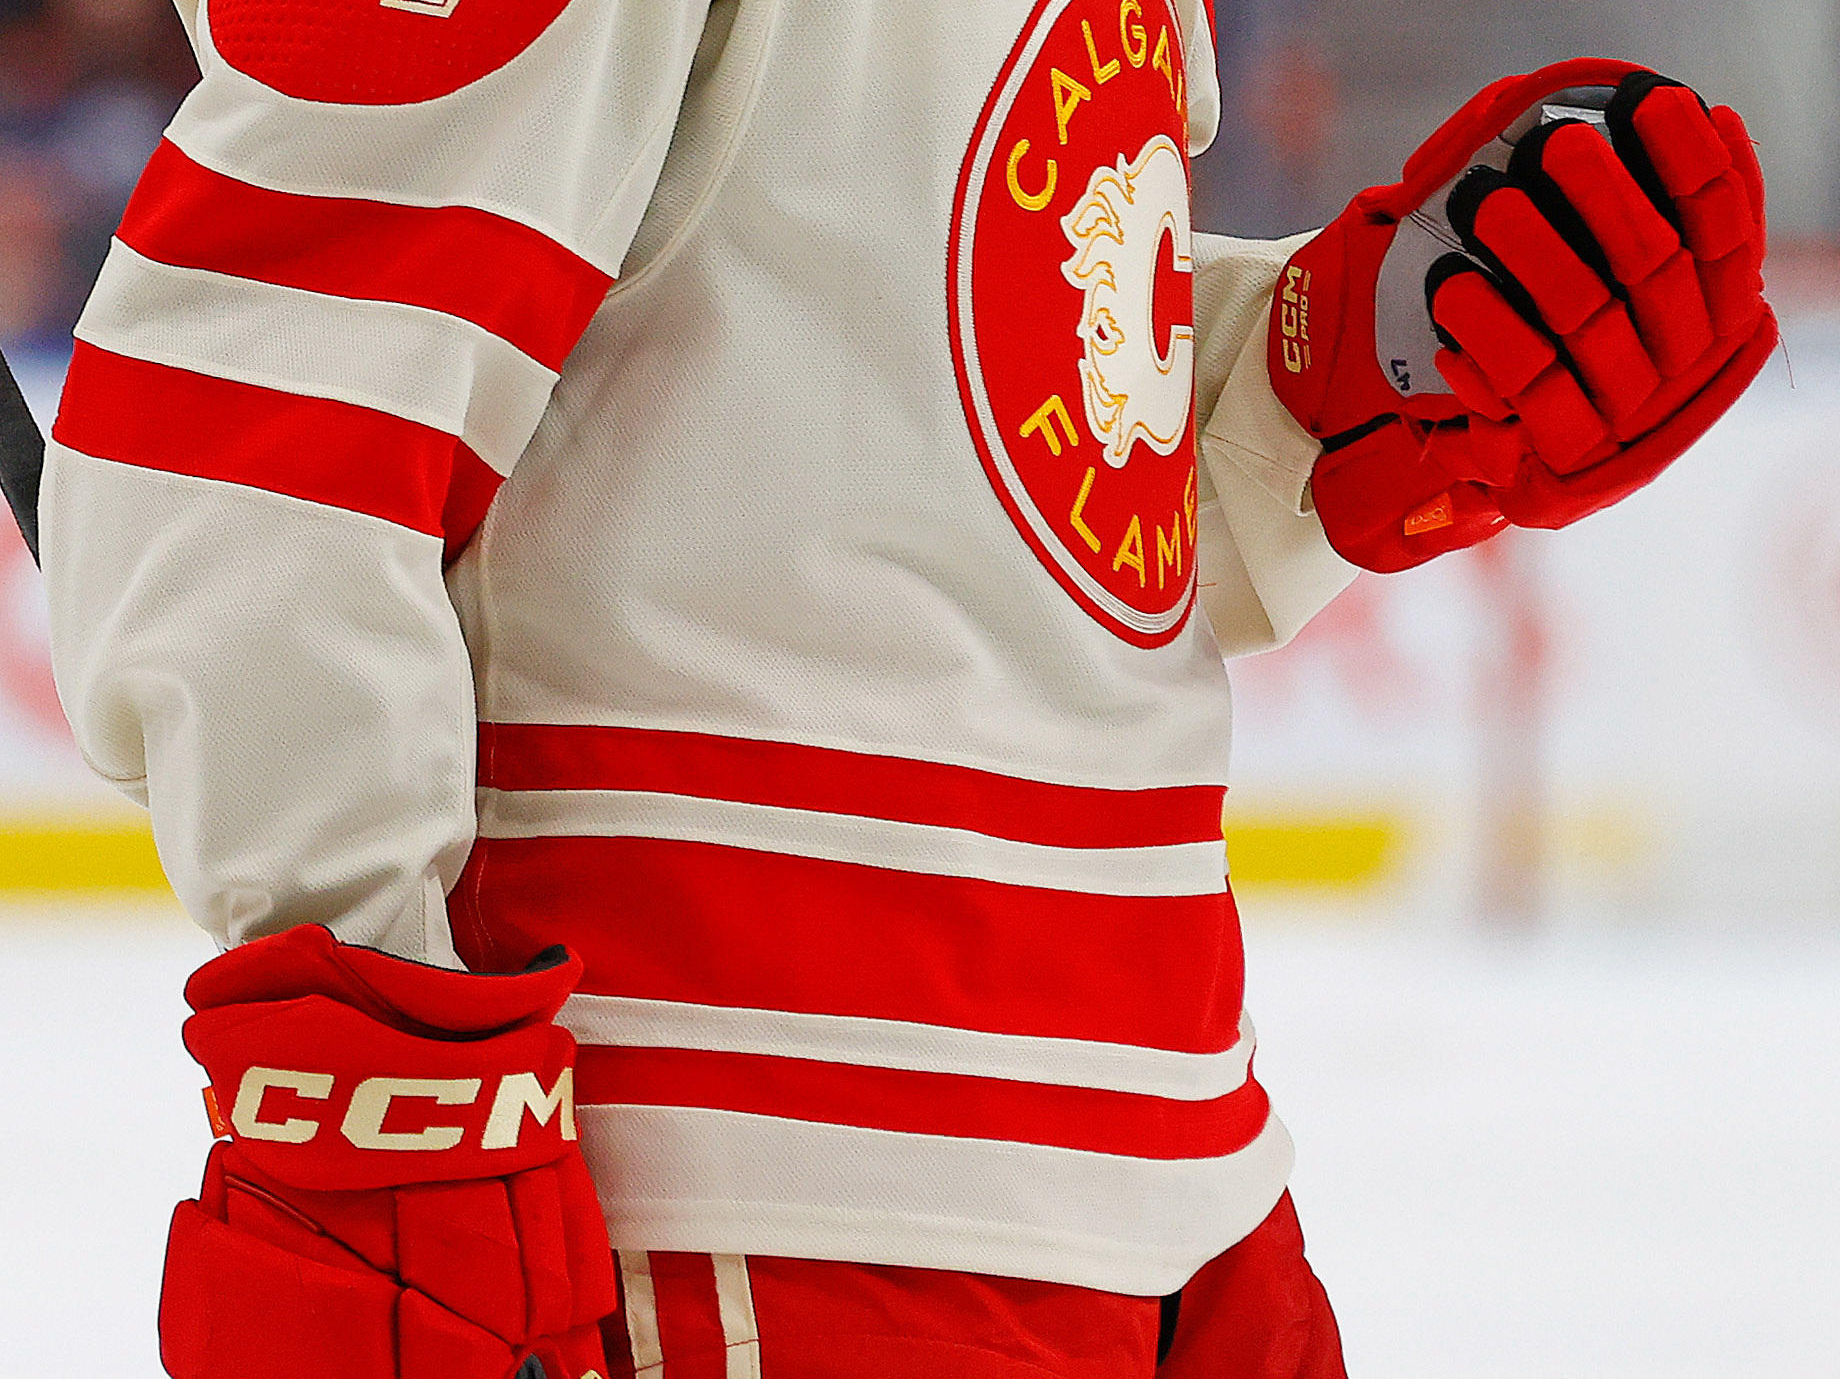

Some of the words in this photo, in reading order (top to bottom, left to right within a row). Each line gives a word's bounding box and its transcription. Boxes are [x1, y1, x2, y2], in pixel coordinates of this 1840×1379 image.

[1282, 265, 1302, 373] CCM
[1300, 294, 1309, 341] PRO
[1020, 394, 1196, 591] FLAME
[231, 1066, 577, 1150] CCM
